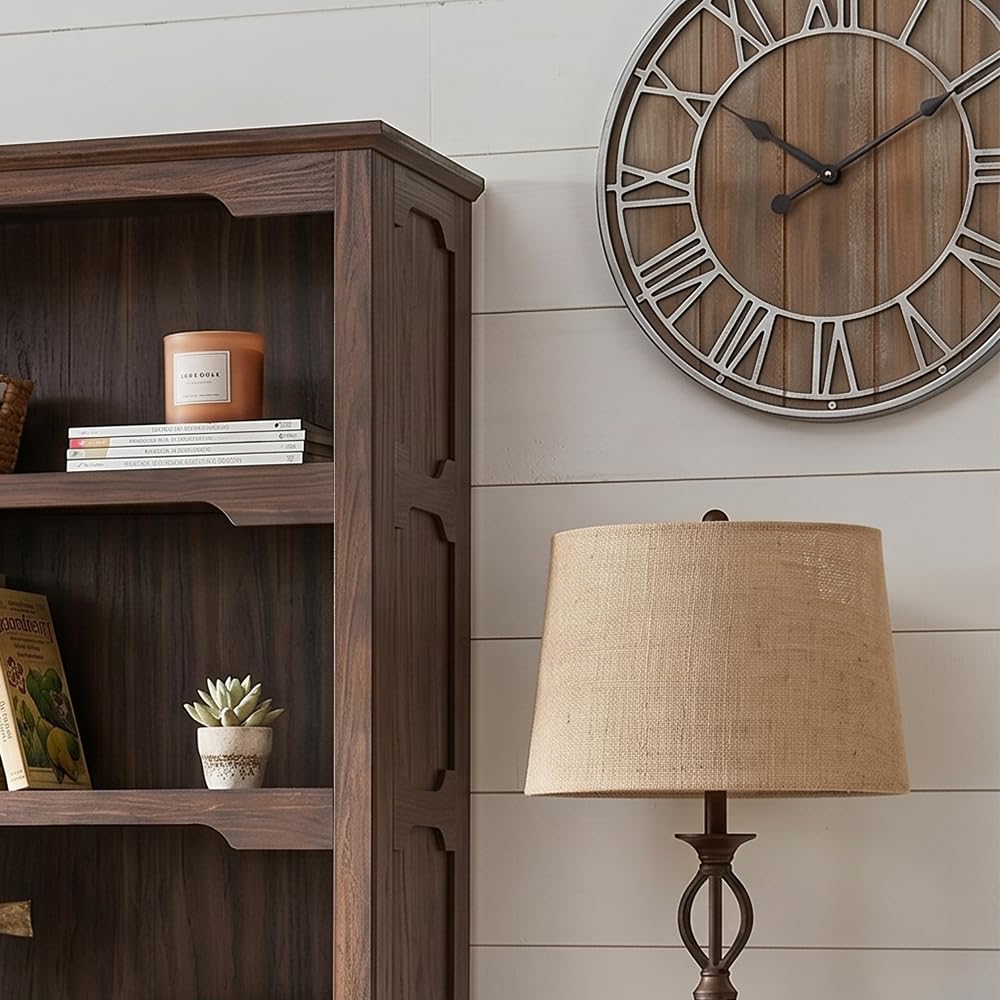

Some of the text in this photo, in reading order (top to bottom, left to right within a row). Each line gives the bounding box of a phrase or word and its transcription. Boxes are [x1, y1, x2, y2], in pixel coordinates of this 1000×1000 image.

[639, 64, 718, 122] X
[620, 158, 692, 208] IX
[636, 230, 720, 325] VIII
[708, 295, 776, 384] VII
[811, 319, 859, 395] VI
[898, 297, 953, 369] V
